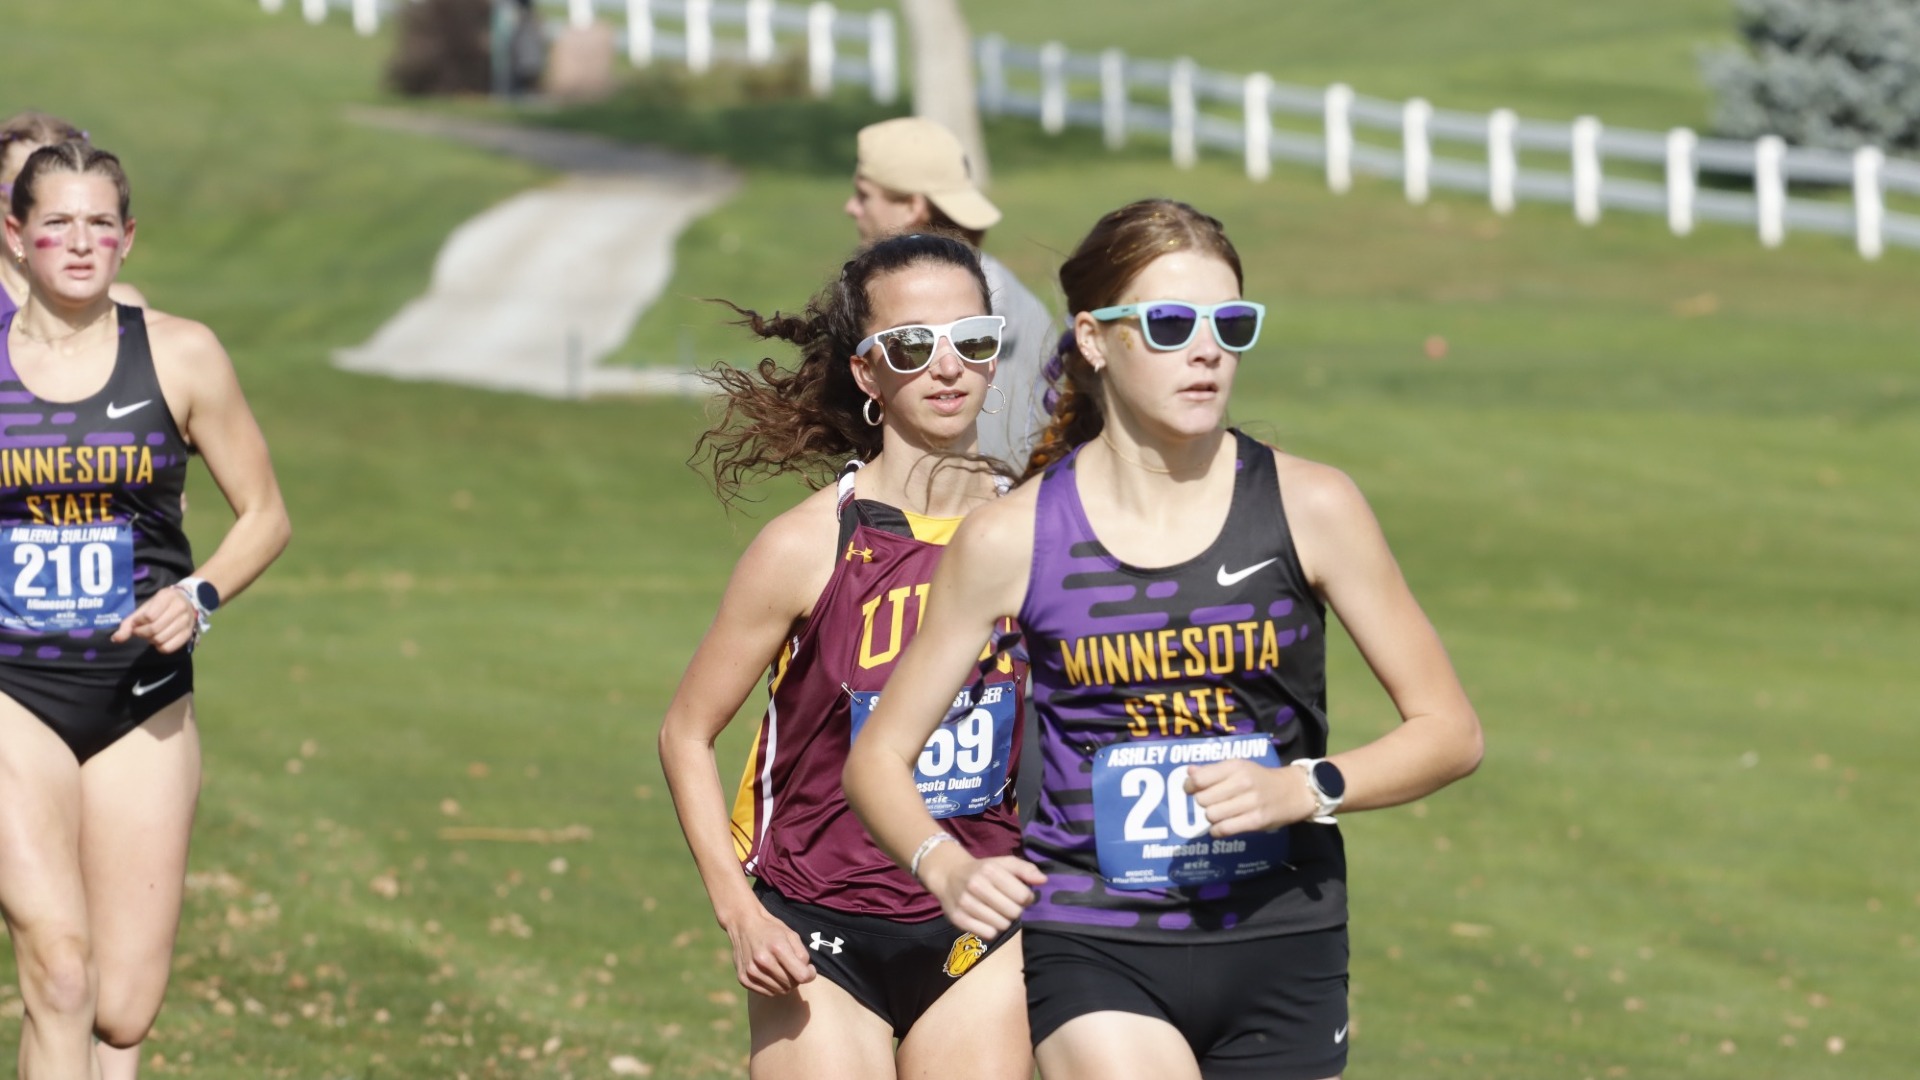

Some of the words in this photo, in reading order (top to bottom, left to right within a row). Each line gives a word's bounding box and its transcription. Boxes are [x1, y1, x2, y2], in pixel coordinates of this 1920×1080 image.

[0, 446, 153, 487] INNESOTA
[26, 493, 115, 526] STATE
[10, 527, 58, 543] MILEENA
[61, 526, 117, 543] SULLIVAN
[13, 543, 113, 597] 210
[27, 599, 76, 610] Minnesota
[77, 597, 104, 609] State
[1060, 620, 1279, 687] MINNESOTA
[952, 687, 1003, 708] STGER
[1124, 687, 1237, 737] STATE
[913, 708, 993, 777] 59
[1107, 745, 1169, 767] ASHLEY
[1169, 738, 1269, 764] OVERGAAUW
[916, 779, 946, 793] esota
[947, 776, 982, 790] Duluth
[1121, 764, 1214, 842] 20
[1142, 842, 1209, 859] Minnesota
[1211, 839, 1247, 855] State
